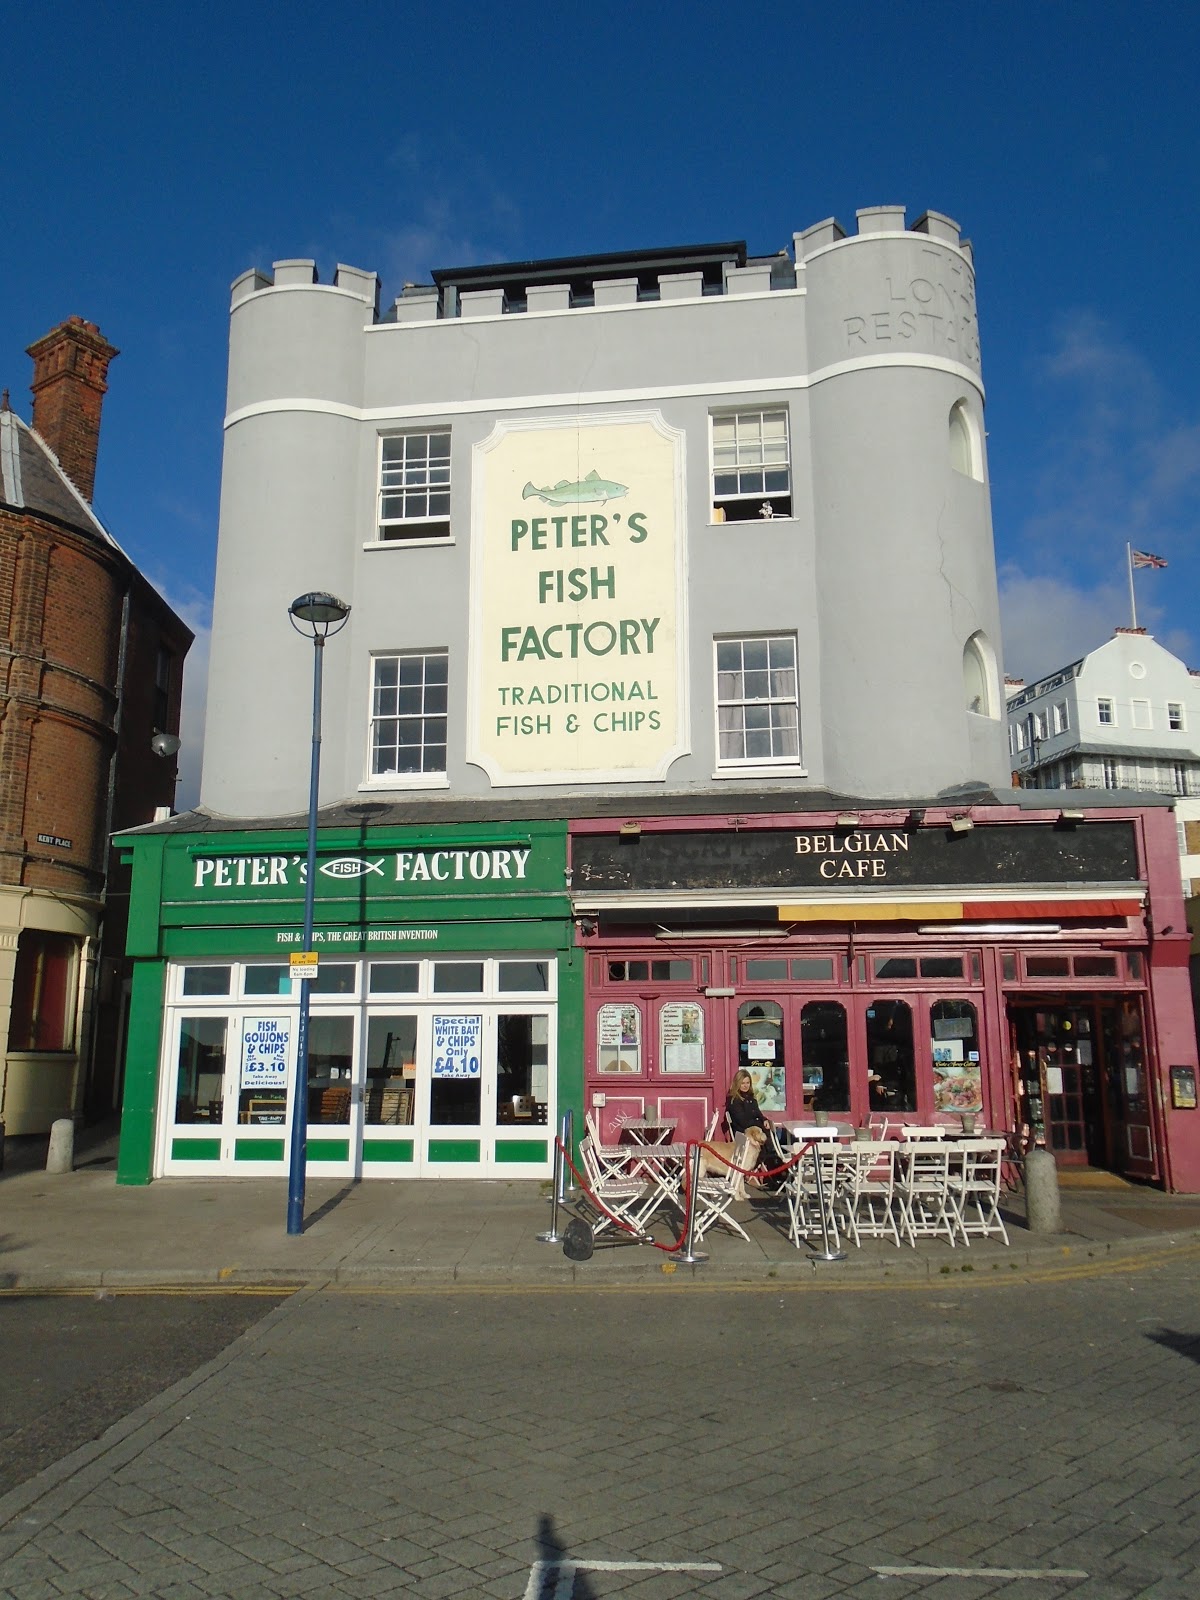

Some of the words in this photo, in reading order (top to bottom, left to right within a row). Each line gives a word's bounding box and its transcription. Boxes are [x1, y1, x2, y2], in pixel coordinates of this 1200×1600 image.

[511, 512, 648, 552] PETER'S
[538, 565, 616, 604] FISH
[501, 617, 661, 663] FACTORY
[498, 680, 659, 706] TRADITIONAL
[496, 714, 551, 737] FISH
[565, 713, 581, 733] &
[593, 710, 661, 733] CHIPS
[38, 834, 53, 844] KENT
[55, 838, 72, 848] PLACE
[794, 833, 909, 854] BELGIAN
[332, 863, 361, 873] FISH
[395, 849, 532, 881] FACTORY
[820, 859, 887, 879] CAFE
[277, 932, 294, 942] FISH
[294, 932, 301, 942] &
[302, 931, 326, 943] IPS,
[327, 931, 342, 942] THE
[343, 931, 367, 941] GREAT
[367, 930, 397, 941] BRITISH
[398, 929, 439, 940] INVENTION
[257, 1021, 277, 1032] FISH
[434, 1016, 480, 1026] Special
[435, 1025, 459, 1035] WHITE
[461, 1025, 480, 1035] BAIT
[244, 1032, 289, 1043] GOUJONS
[436, 1035, 445, 1047] &
[447, 1035, 476, 1047] CHIPS
[247, 1043, 256, 1054] &
[258, 1043, 285, 1054] CHIPS
[446, 1047, 469, 1057] Only
[248, 1062, 285, 1072] £3.10
[434, 1056, 479, 1073] £4.10
